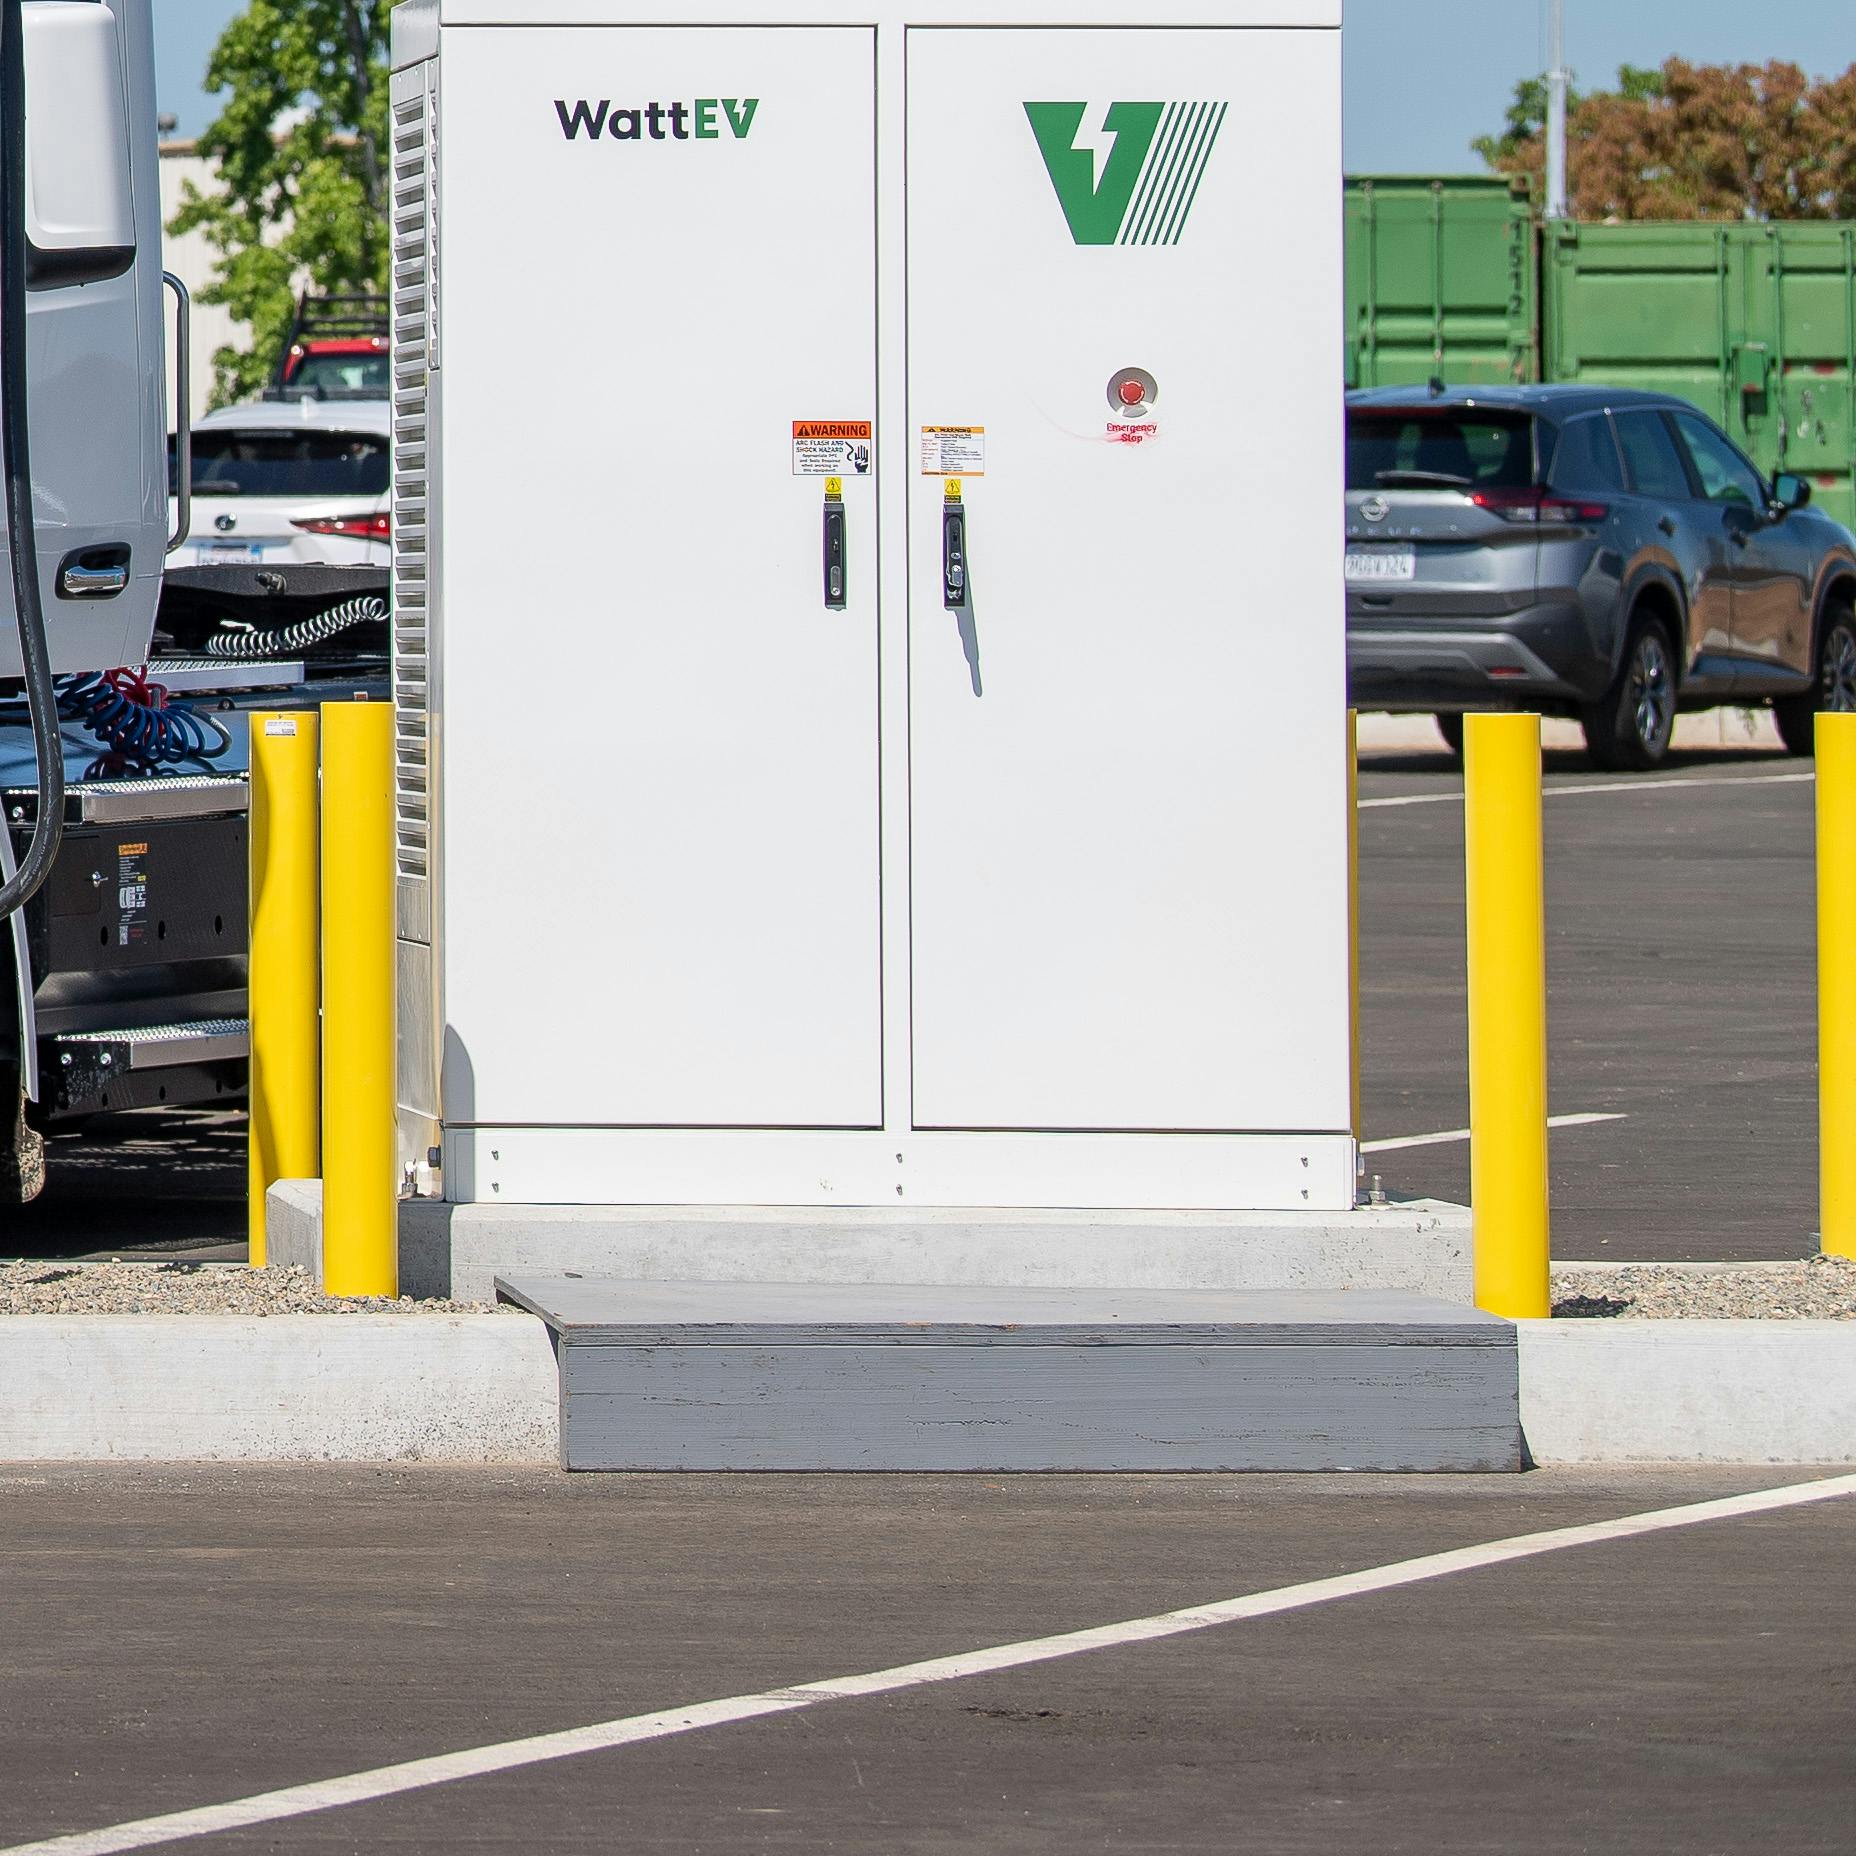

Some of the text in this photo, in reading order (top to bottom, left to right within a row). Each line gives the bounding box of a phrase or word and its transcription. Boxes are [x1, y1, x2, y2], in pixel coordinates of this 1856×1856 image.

[553, 98, 760, 140] WattEV
[810, 424, 867, 436] WARNING
[1106, 422, 1157, 434] Emergency
[1121, 433, 1143, 444] Stop
